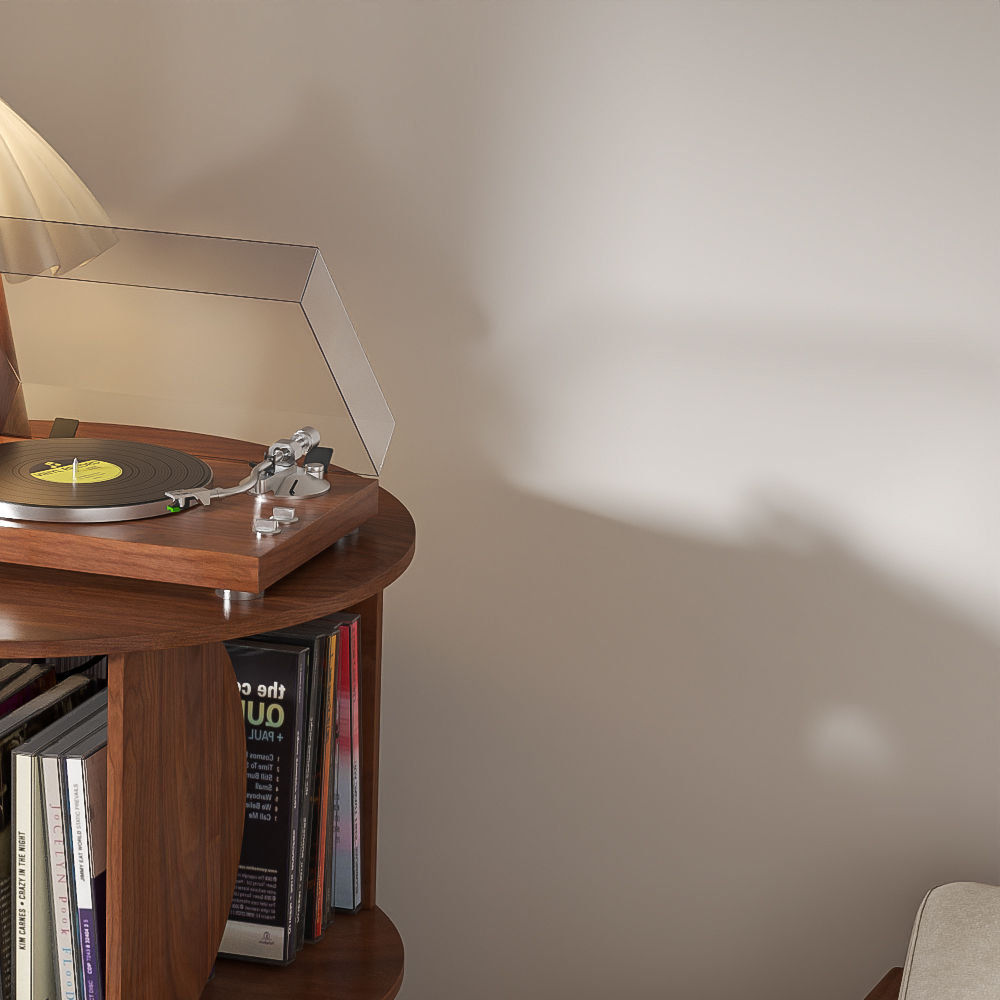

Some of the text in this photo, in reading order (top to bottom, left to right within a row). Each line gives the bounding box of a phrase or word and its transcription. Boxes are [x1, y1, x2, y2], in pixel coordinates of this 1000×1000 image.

[75, 830, 83, 851] WORLD
[18, 830, 26, 950] KIM CARNES CRAZY IN THE NIGHT
